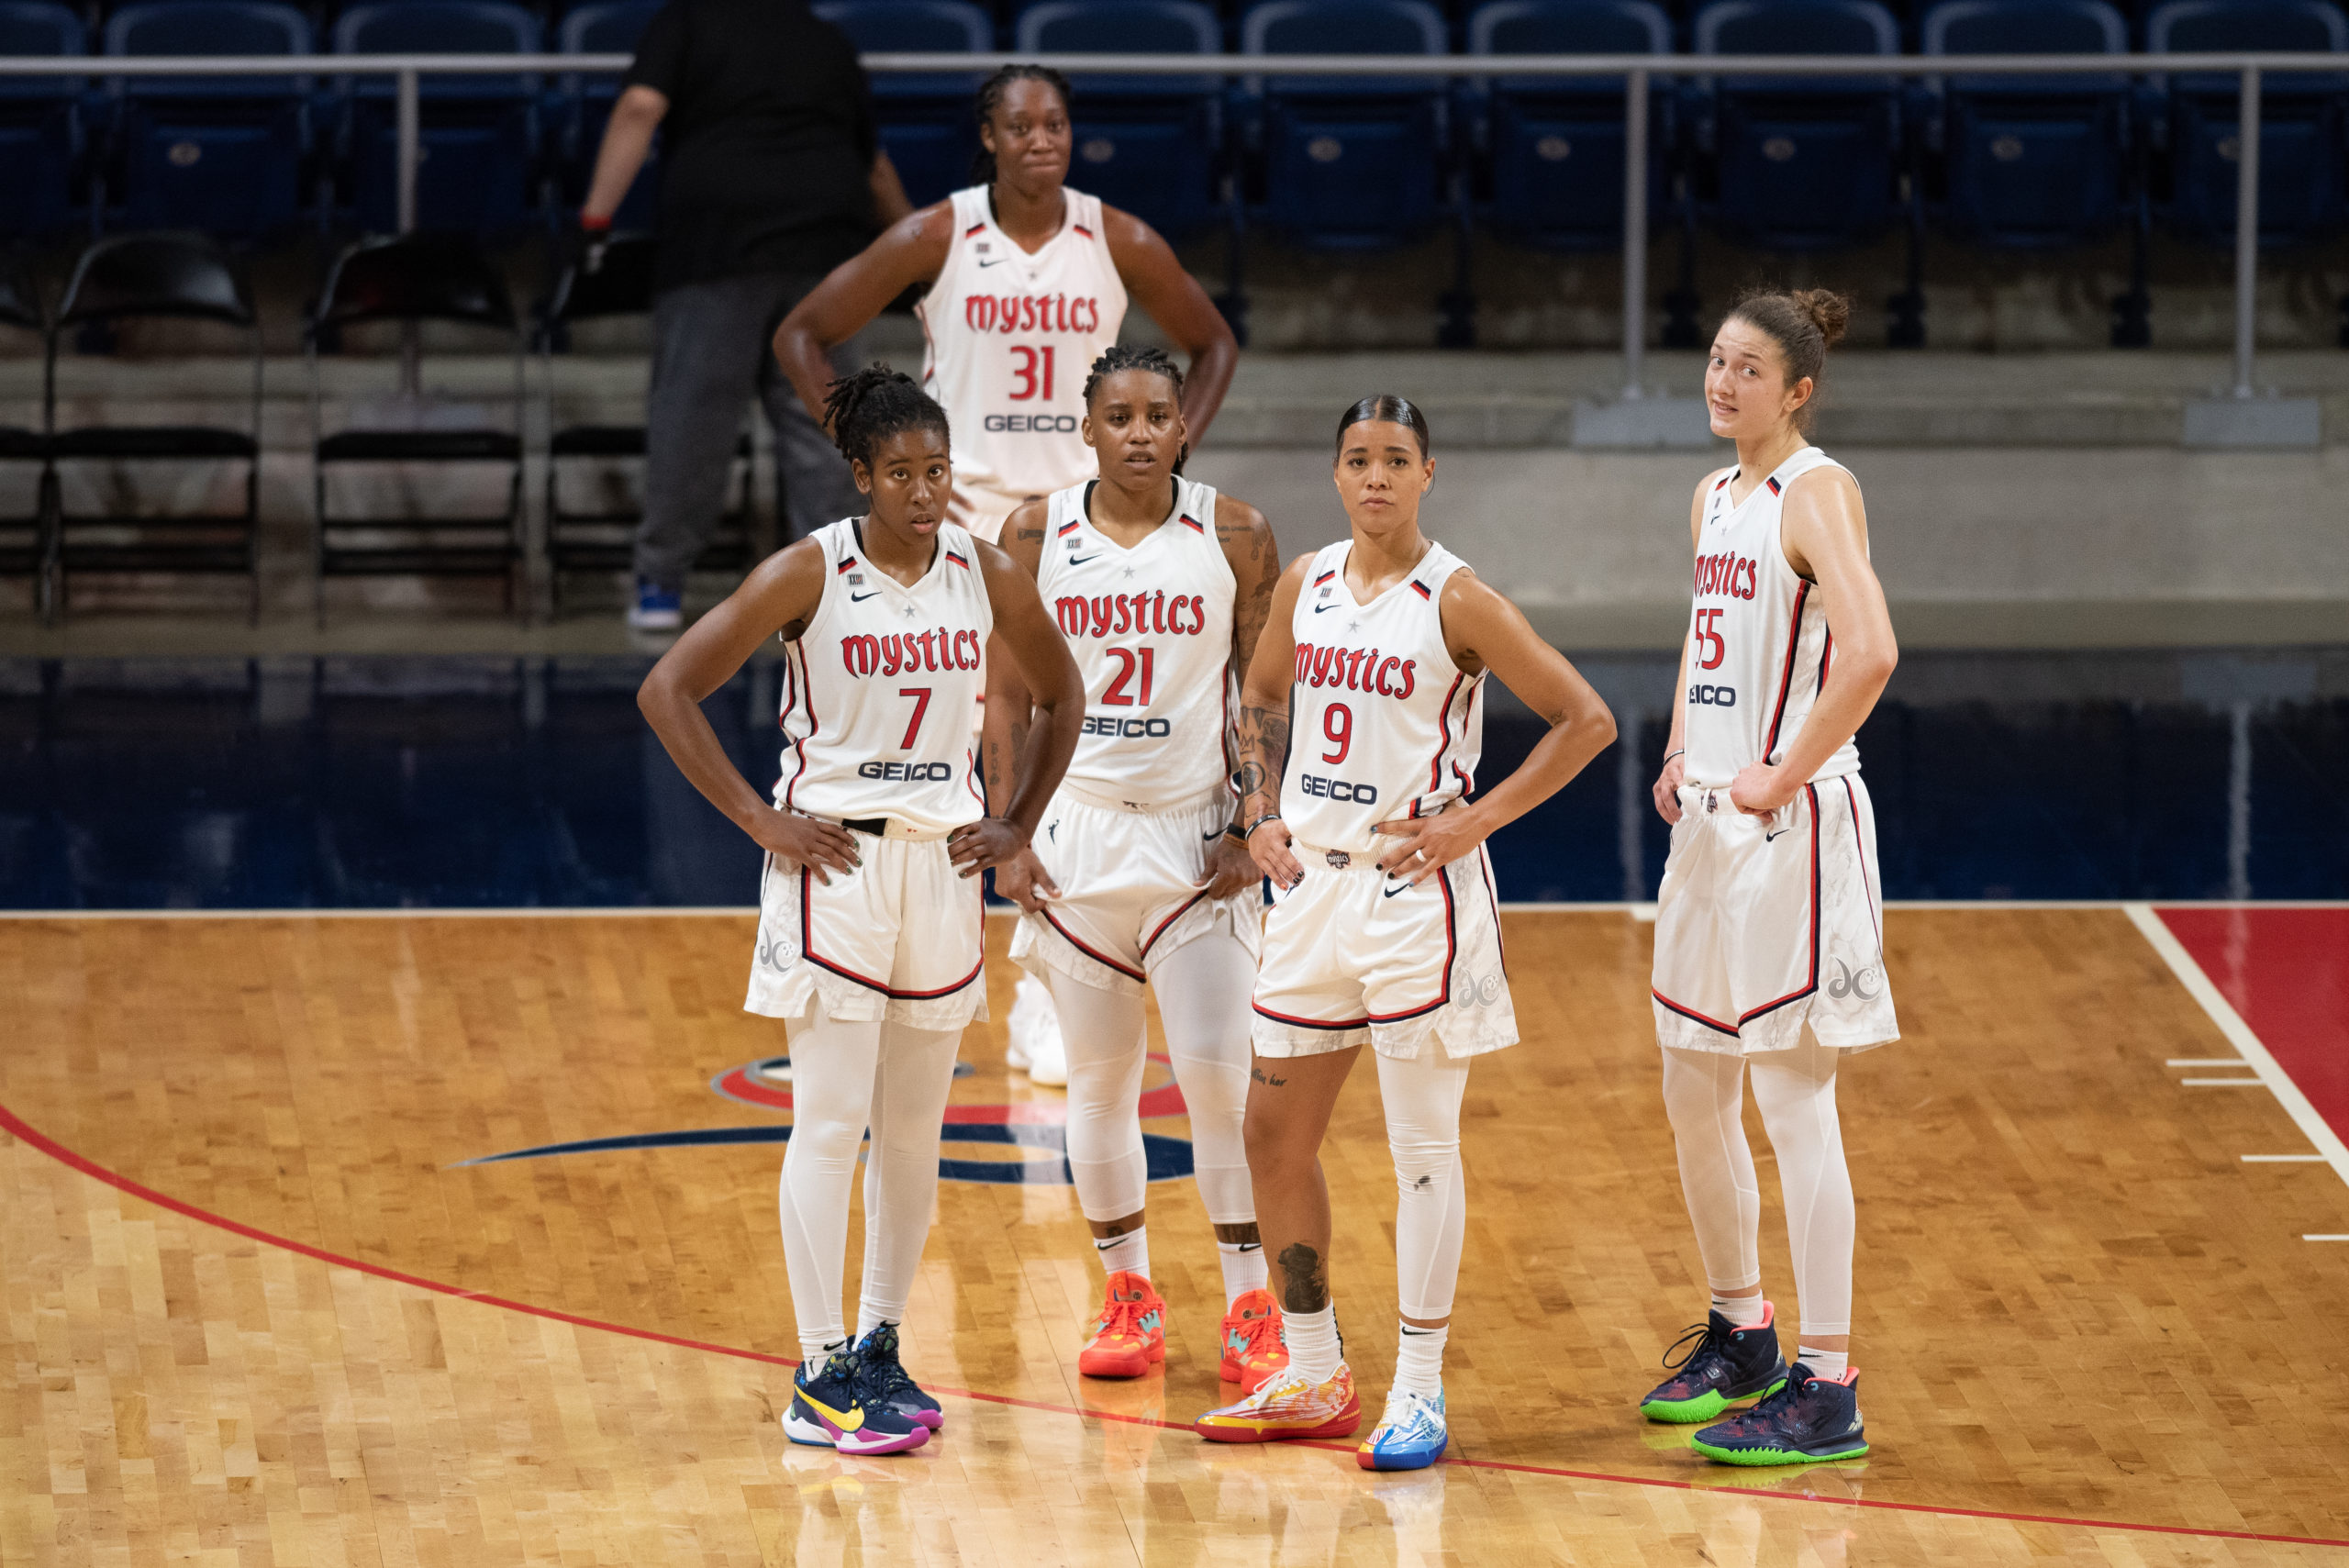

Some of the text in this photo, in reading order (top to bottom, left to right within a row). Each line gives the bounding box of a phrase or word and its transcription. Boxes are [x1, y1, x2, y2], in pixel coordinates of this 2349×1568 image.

[1009, 345, 1055, 401] 31
[985, 415, 1077, 433] GEICO
[1695, 608, 1725, 671] 55
[1101, 648, 1154, 706] 21
[898, 687, 932, 751] 7
[1081, 716, 1172, 739] GEICO
[1321, 702, 1353, 765] 9
[857, 761, 952, 783] GEICO
[1301, 773, 1378, 806] GEICO
